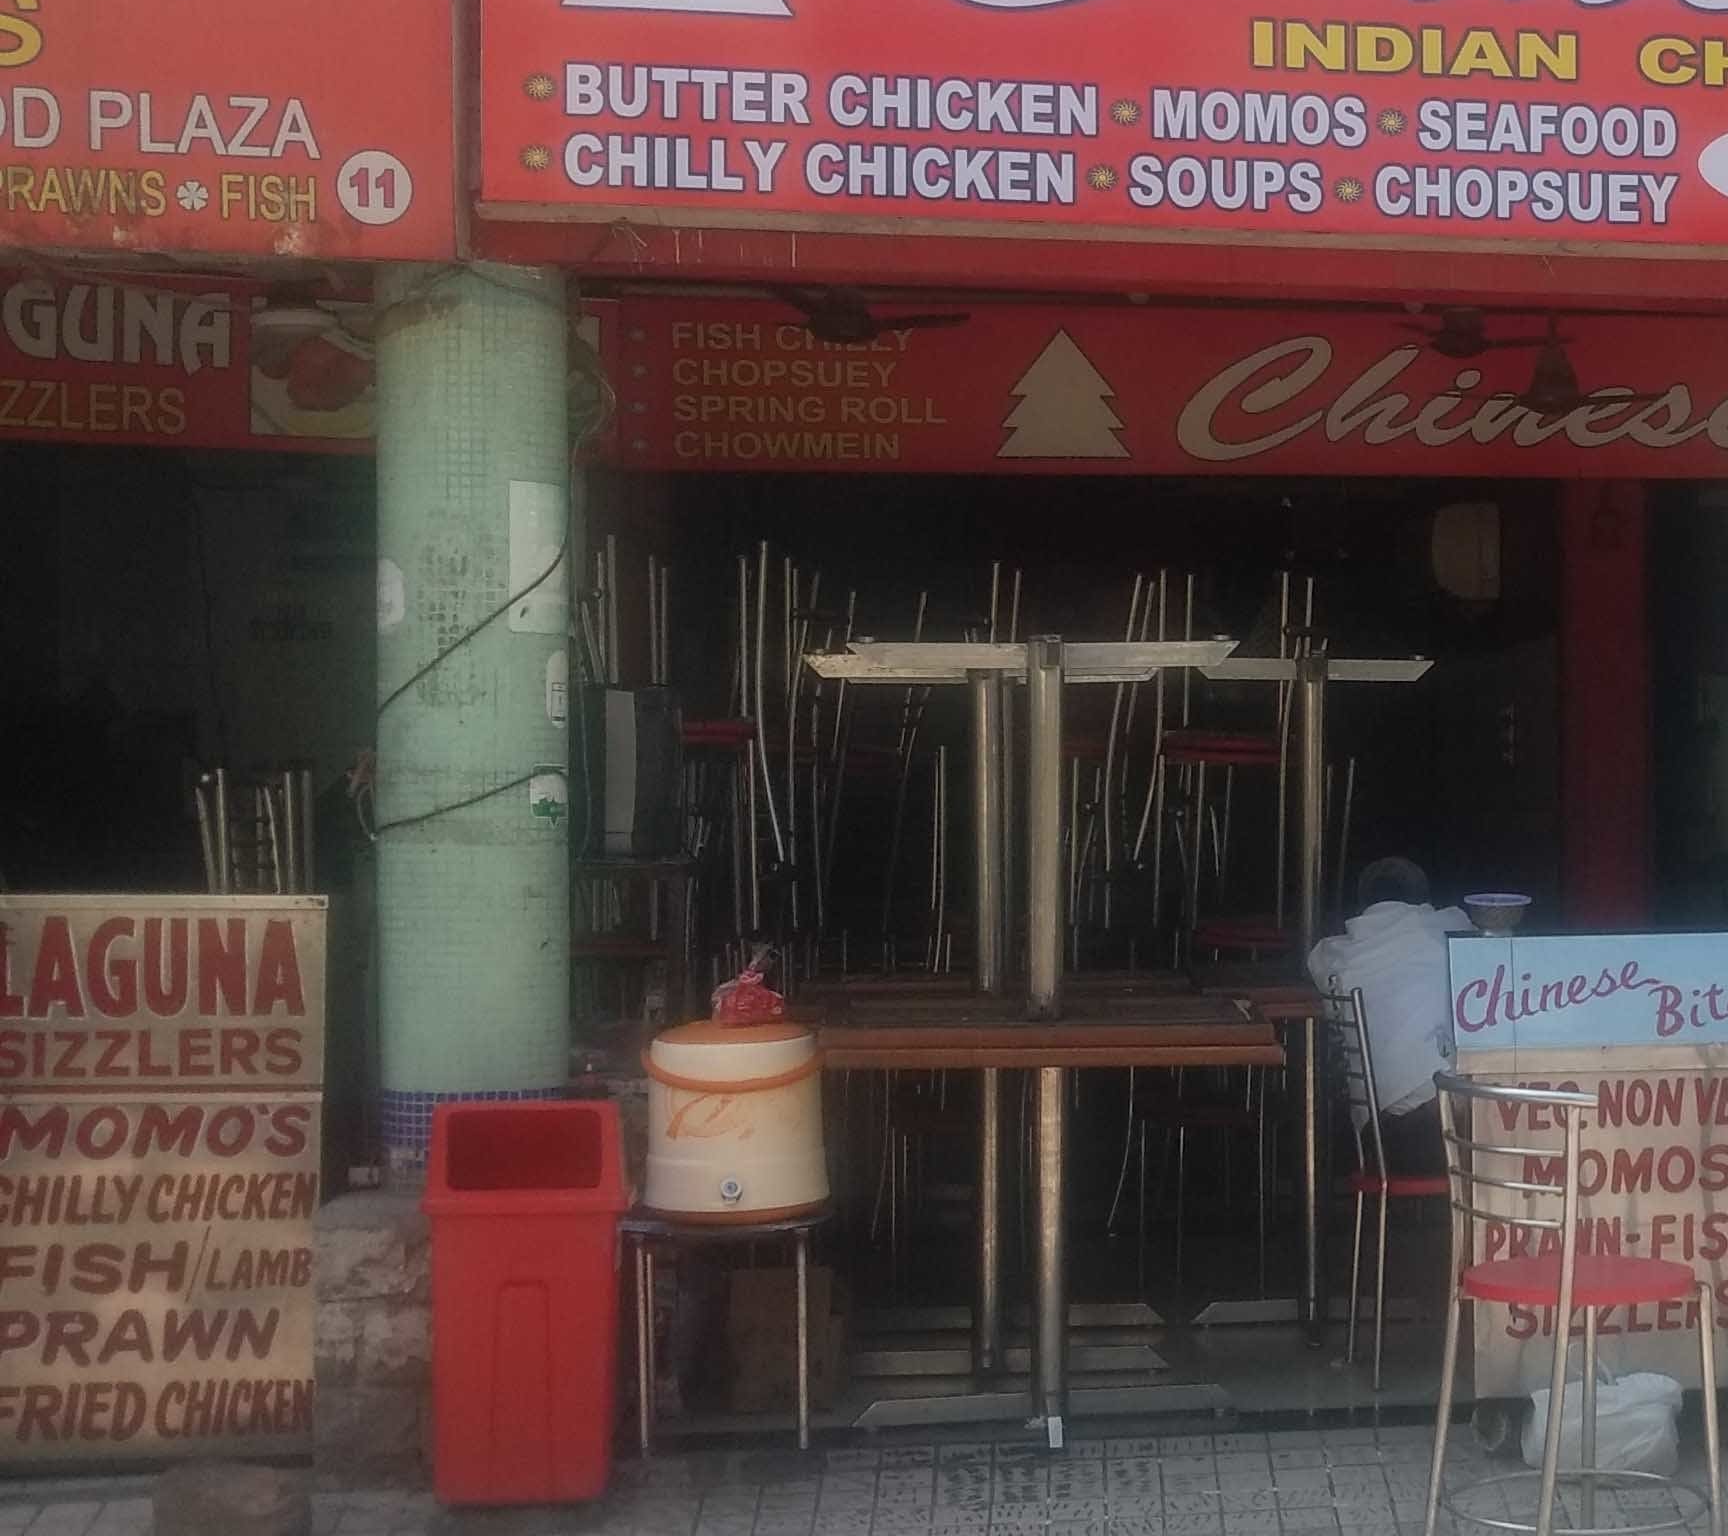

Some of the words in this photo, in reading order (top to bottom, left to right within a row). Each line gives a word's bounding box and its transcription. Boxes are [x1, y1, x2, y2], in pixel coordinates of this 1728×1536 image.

[1252, 19, 1578, 81] INDIAN
[89, 89, 321, 161] PLAZA
[565, 64, 809, 126] BUTTER
[829, 74, 1099, 138] CHICKEN
[1152, 89, 1368, 149] MOMOS
[1418, 100, 1678, 159] SEAFOOD
[220, 174, 317, 224] FISH
[348, 166, 400, 211] 11
[564, 133, 787, 194] CHILLY
[804, 142, 1075, 205] CHICKEN
[1128, 153, 1324, 213] SOUPS
[1374, 165, 1679, 225] CHOPSUEY
[671, 321, 761, 351] FISH
[671, 358, 897, 389] CHOPSUEY
[672, 394, 825, 423] SPRING
[839, 396, 948, 424] ROLL
[672, 430, 900, 460] CHOWMEIN
[0, 915, 305, 1019] LAGUNA
[1455, 958, 1662, 1033] Chinese
[0, 1027, 304, 1079] SIZZLERS
[1597, 1077, 1685, 1129] NON
[0, 1103, 313, 1161] MOMO'S
[146, 1172, 319, 1223] CHICKEN
[155, 1377, 315, 1440] CHICKEN
